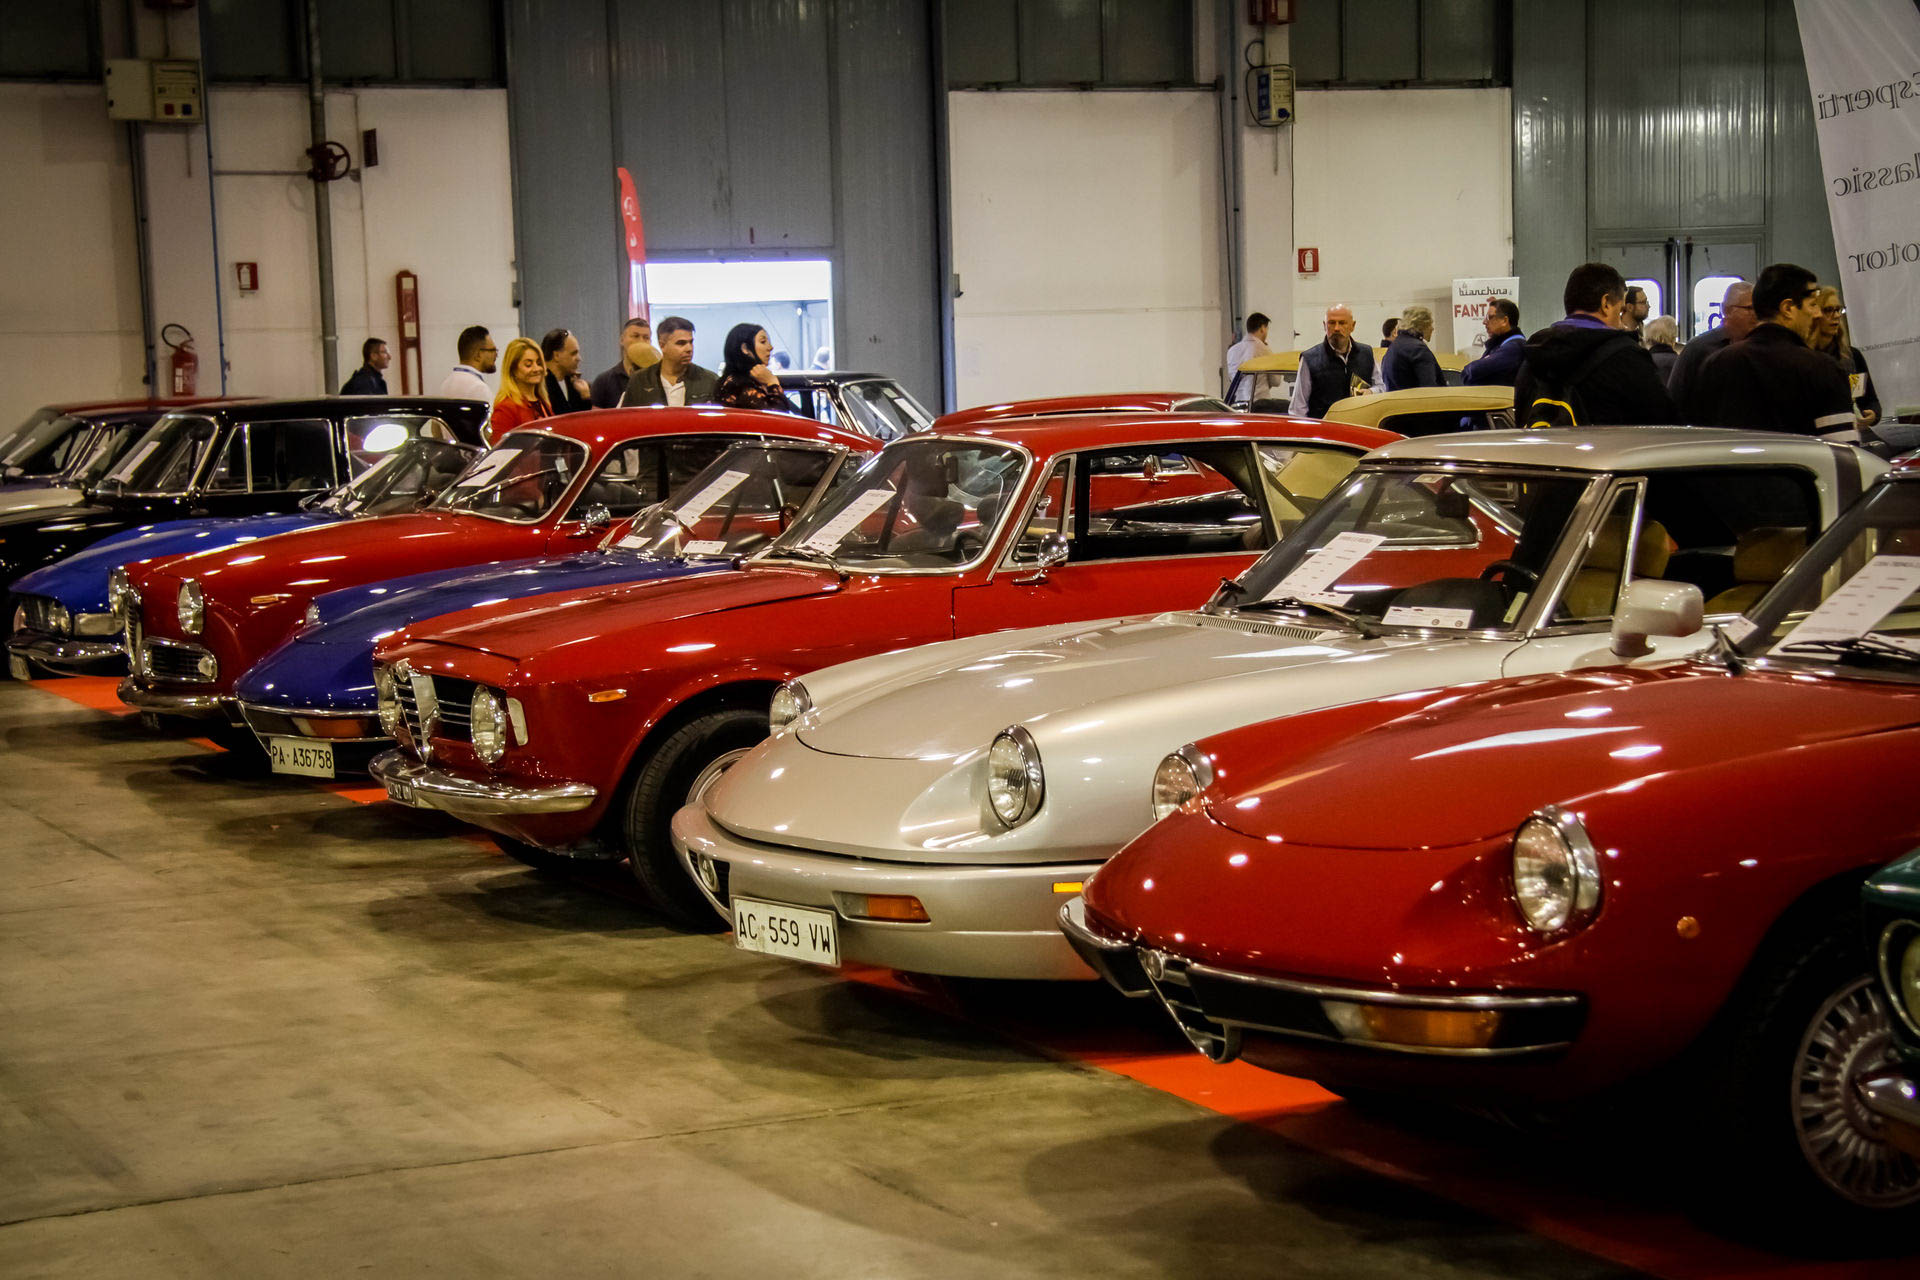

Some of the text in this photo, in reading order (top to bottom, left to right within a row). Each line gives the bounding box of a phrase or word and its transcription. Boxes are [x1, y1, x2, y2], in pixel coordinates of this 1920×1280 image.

[1454, 303, 1487, 318] FANT
[272, 745, 332, 769] PA A36758
[740, 911, 831, 953] AC 559 VW
